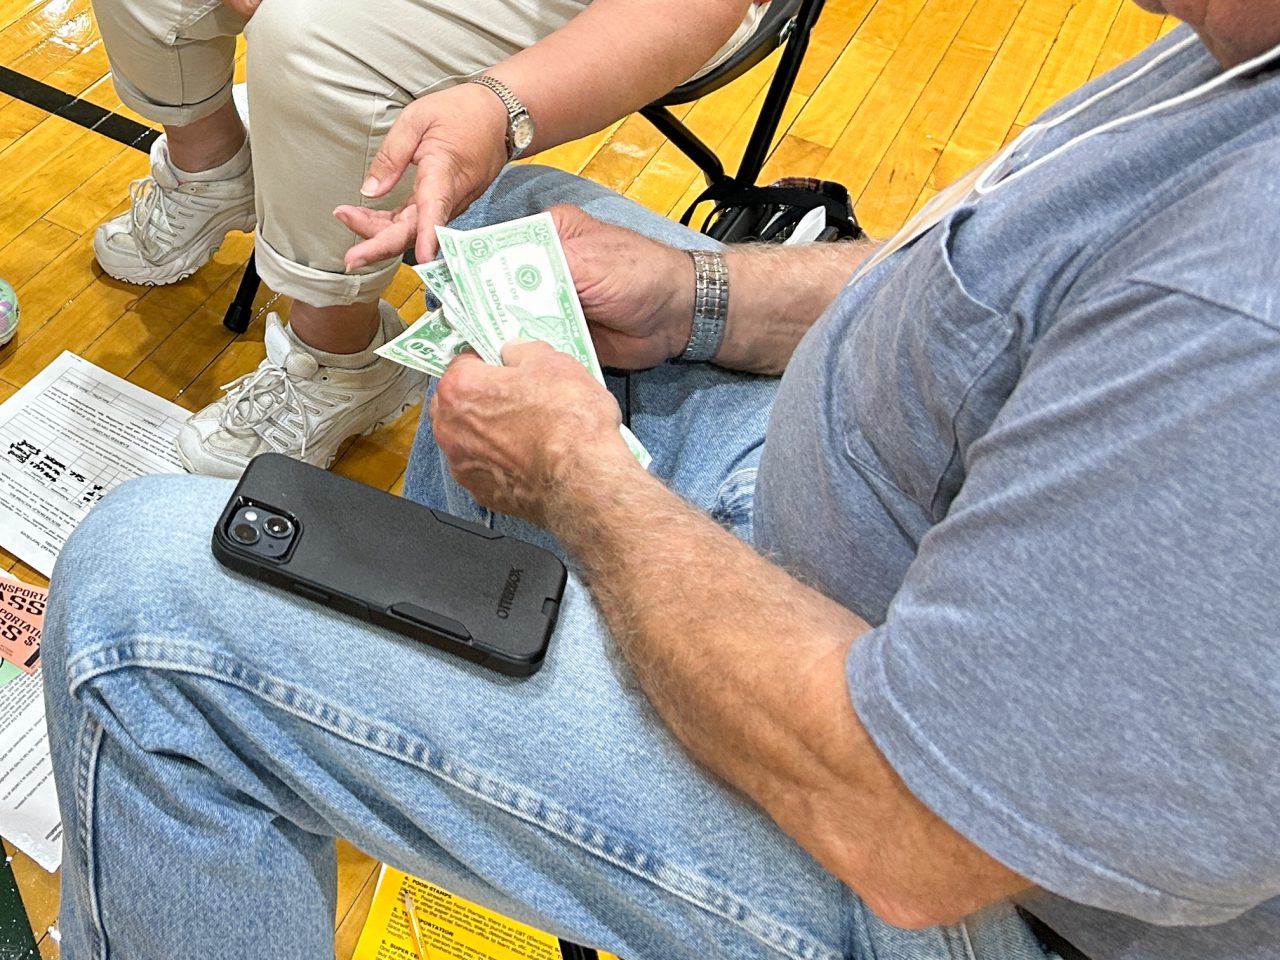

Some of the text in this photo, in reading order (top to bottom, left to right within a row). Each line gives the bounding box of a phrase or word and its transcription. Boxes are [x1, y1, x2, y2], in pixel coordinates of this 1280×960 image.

[486, 279, 508, 325] TENDER
[411, 878, 428, 889] FOOD
[428, 886, 452, 899] STAMPS
